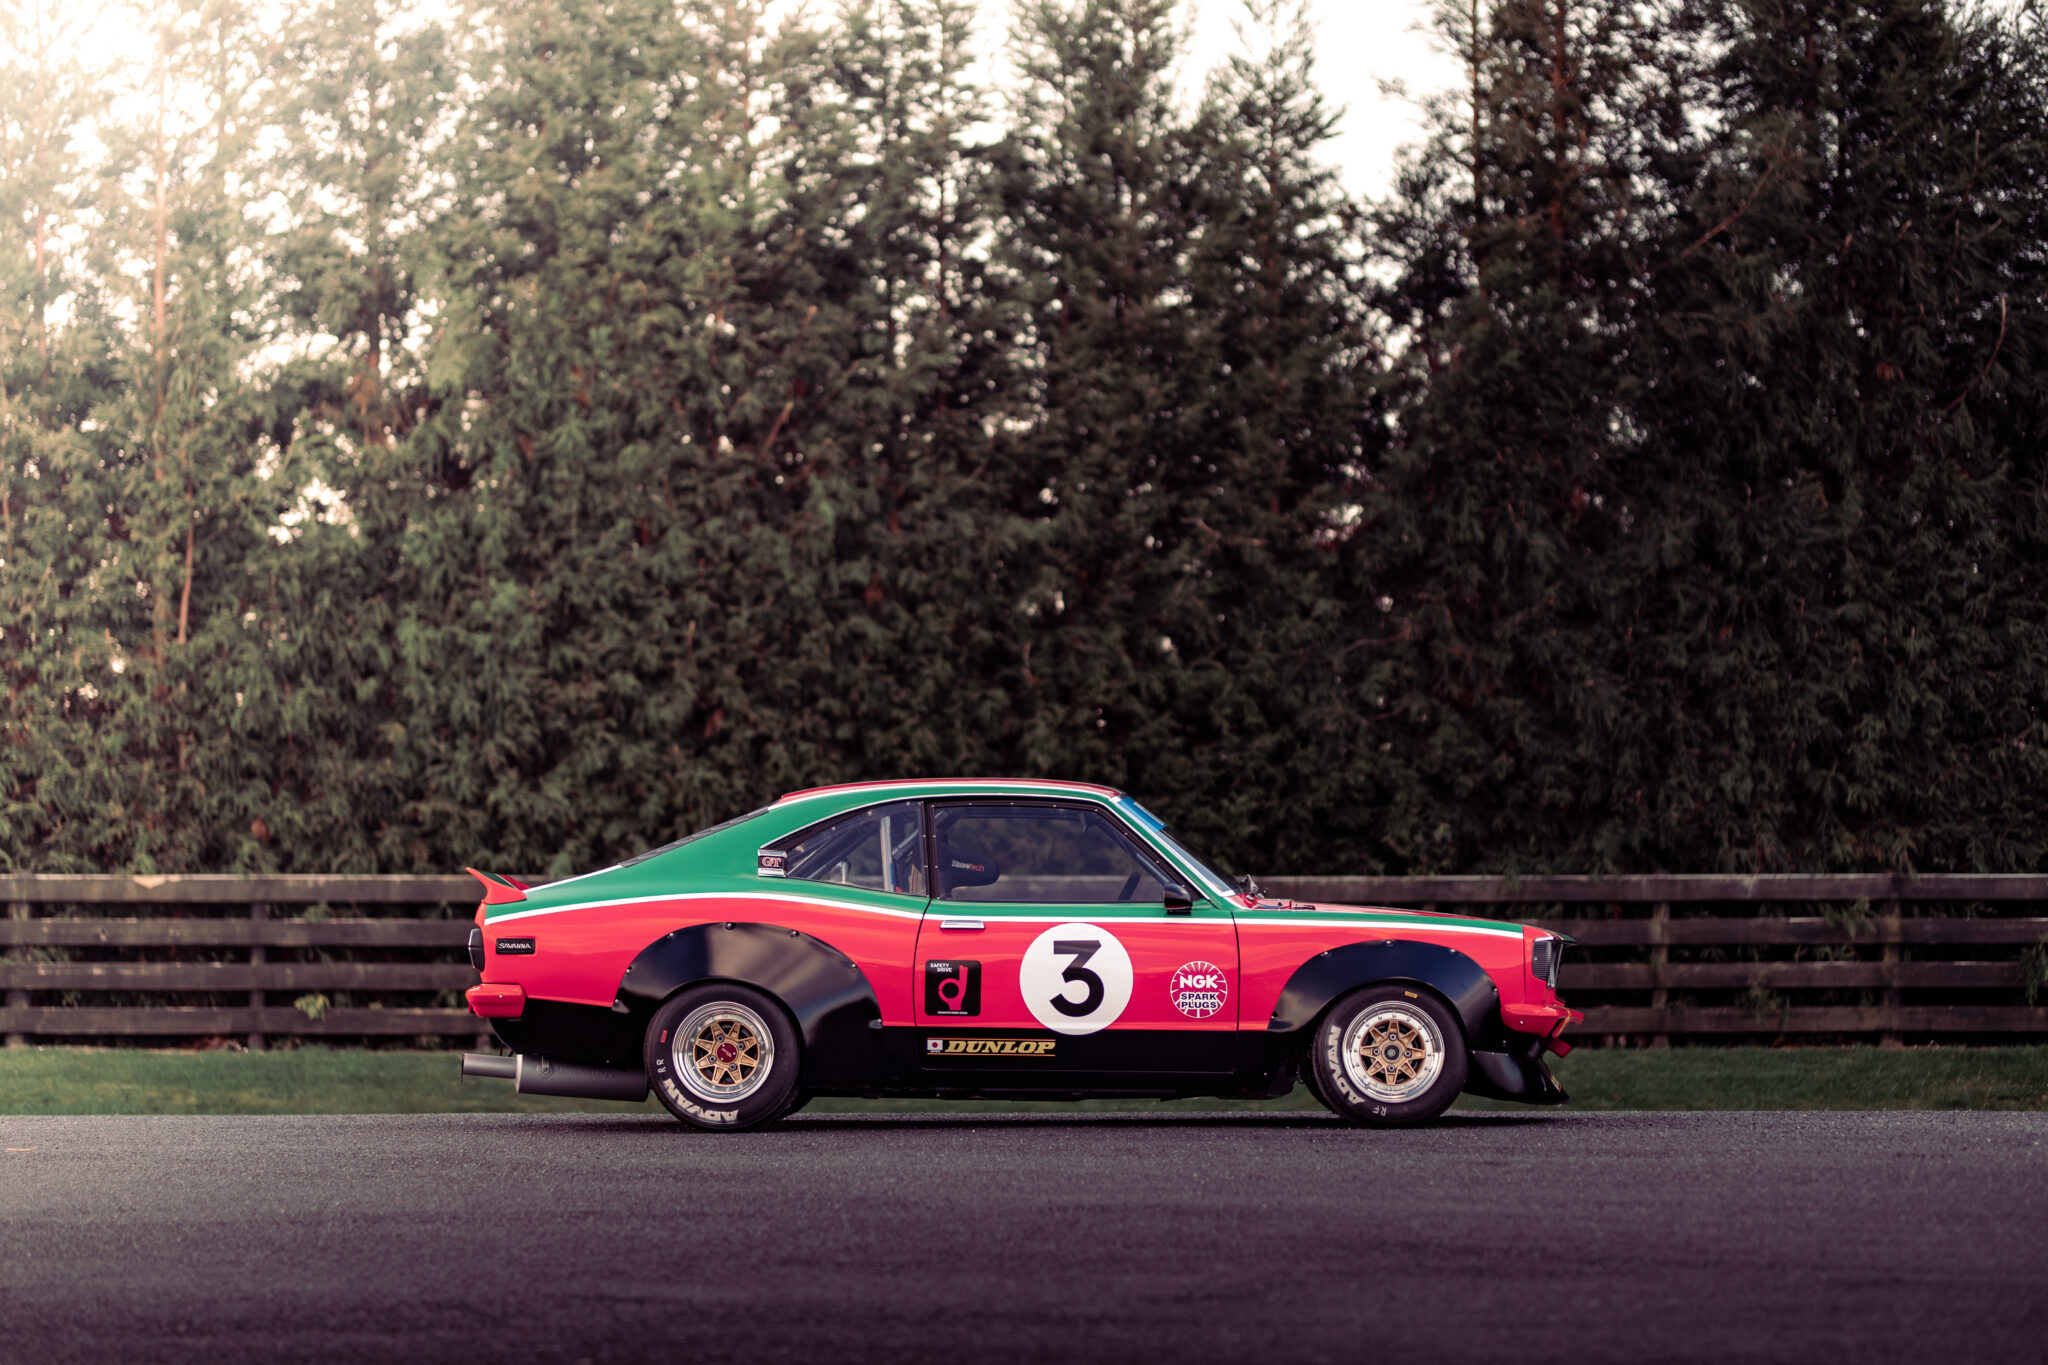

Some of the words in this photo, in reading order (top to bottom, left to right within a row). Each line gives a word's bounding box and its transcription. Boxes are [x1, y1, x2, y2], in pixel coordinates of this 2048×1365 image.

[762, 857, 782, 868] GT
[1050, 940, 1104, 1017] 3
[1179, 974, 1218, 989] NGK
[1181, 993, 1217, 1001] SPARK
[1181, 1001, 1217, 1009] PLUGS
[944, 1040, 1056, 1054] DUNLOP
[1328, 1025, 1365, 1105] ADVAN
[664, 1078, 740, 1121] ADVAN
